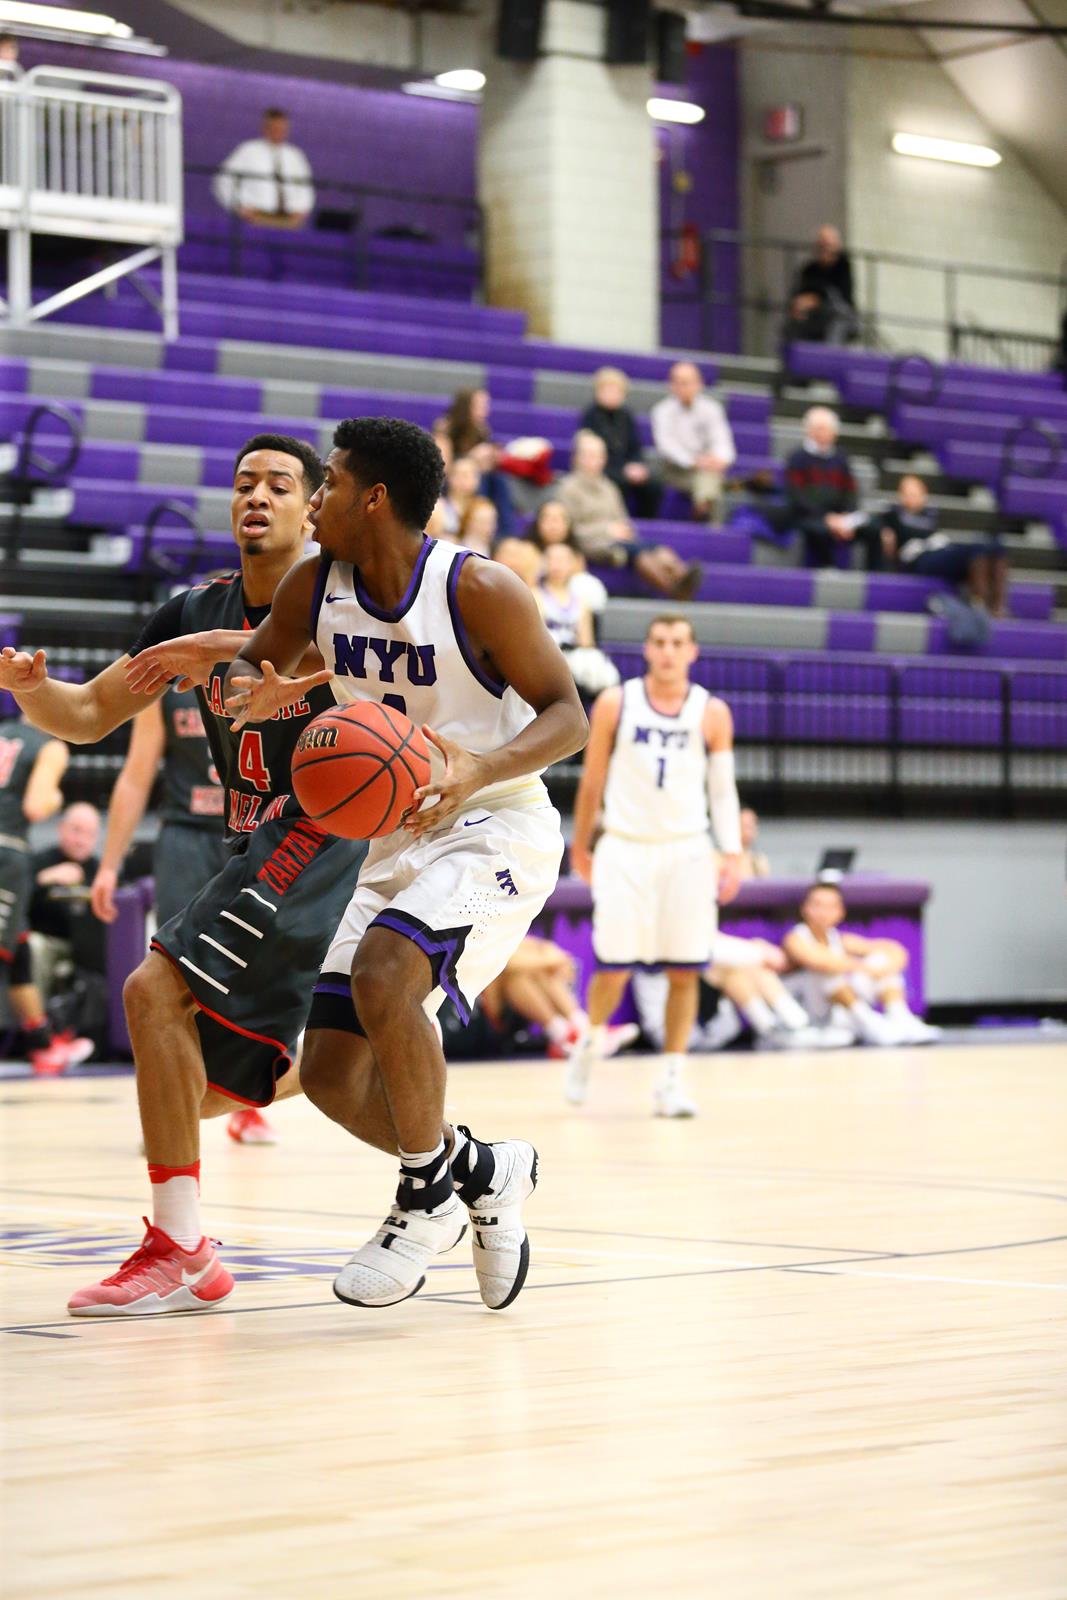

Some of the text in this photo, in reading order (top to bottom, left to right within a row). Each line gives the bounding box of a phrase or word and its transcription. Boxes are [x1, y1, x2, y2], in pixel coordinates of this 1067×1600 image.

[333, 633, 437, 687] NYU
[239, 730, 272, 792] 4
[656, 757, 667, 789] 1
